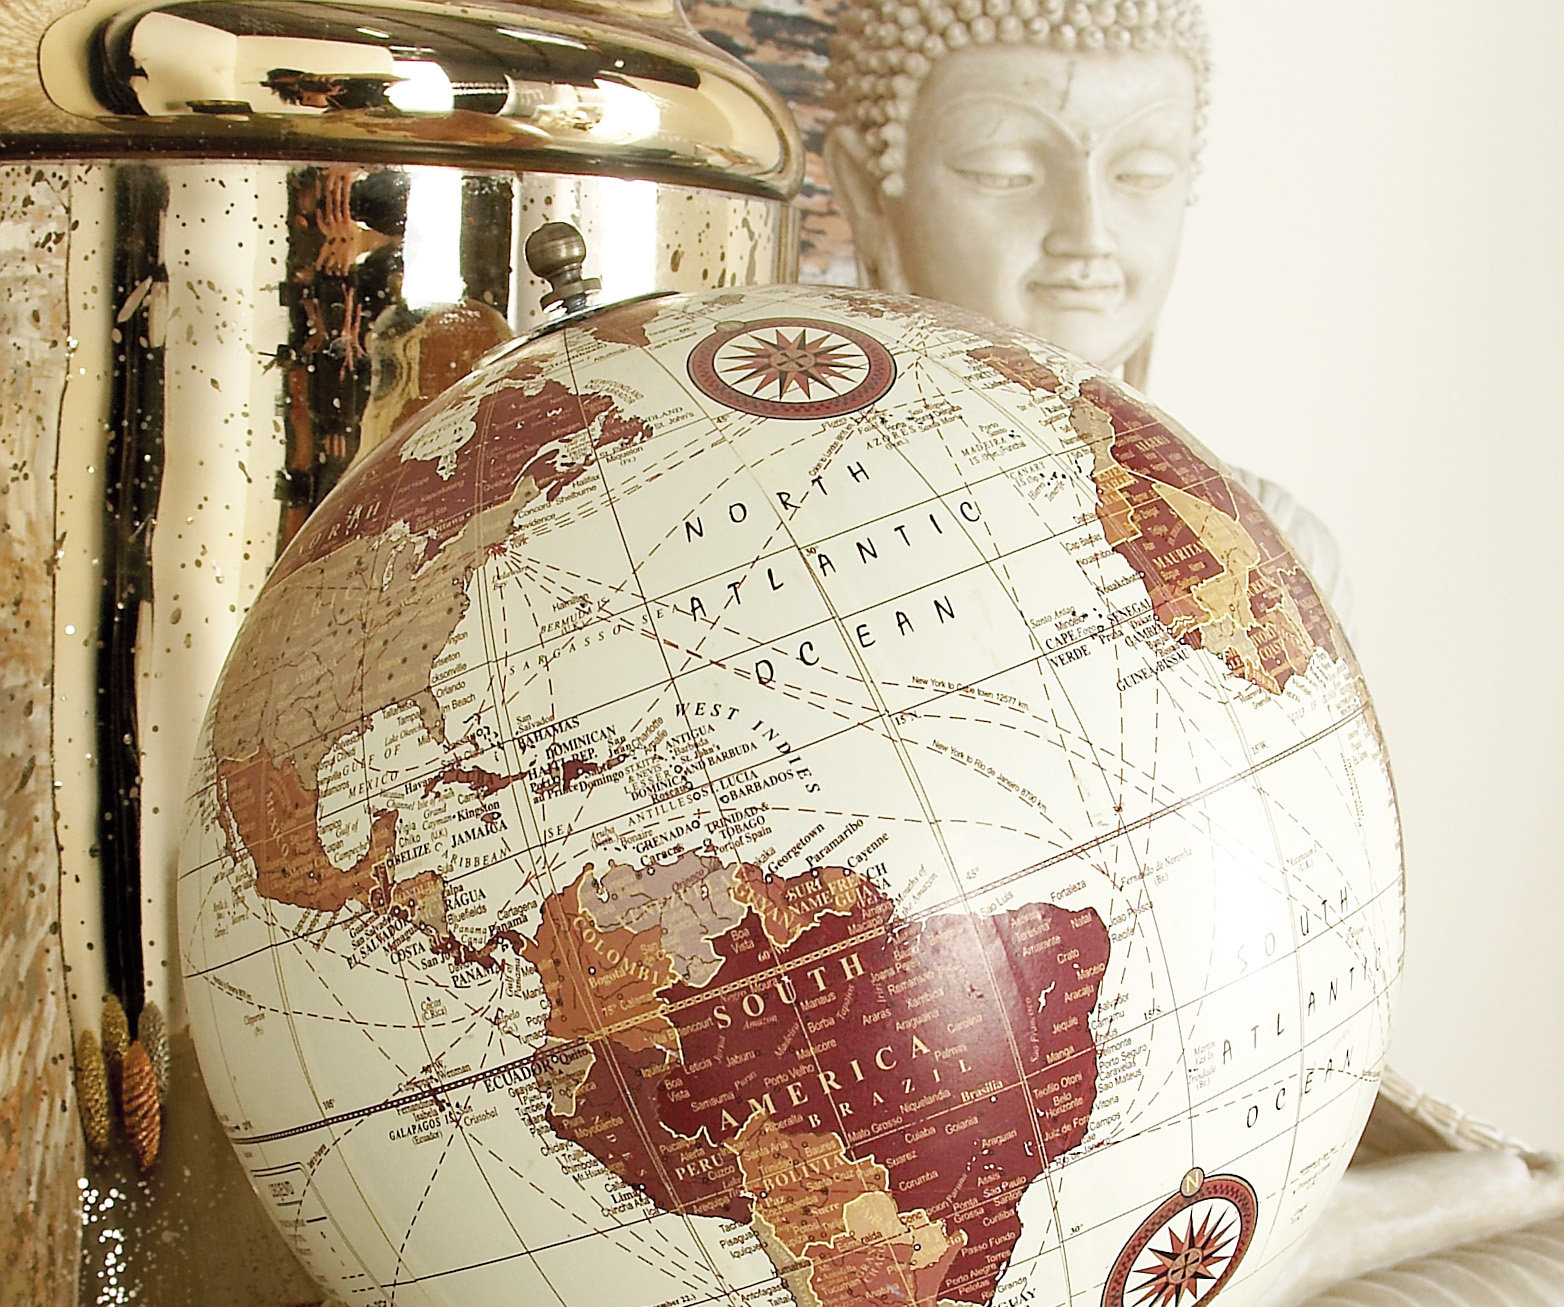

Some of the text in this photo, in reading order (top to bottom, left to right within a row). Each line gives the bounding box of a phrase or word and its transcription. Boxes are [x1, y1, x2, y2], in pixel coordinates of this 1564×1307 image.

[556, 485, 598, 506] Shelburne
[685, 461, 870, 542] NORTH
[517, 502, 553, 519] Concord
[689, 501, 980, 621] ATLANTIC
[755, 595, 956, 685] OCEAN
[1046, 629, 1077, 650] CAPE
[1049, 645, 1091, 668] VERDE
[435, 680, 466, 699] Orlando
[517, 718, 580, 750] BAHAMAS
[546, 725, 617, 760] DOMINICAN
[665, 724, 715, 749] ANTIGUA
[675, 702, 820, 794] WEST INDIES
[707, 742, 758, 766] BARBUDA
[579, 770, 624, 792] Domingo
[720, 770, 758, 790] LUCIA
[730, 769, 795, 801] BARBADOS
[457, 801, 500, 822] Kingston
[628, 796, 694, 826] ANTILLES
[704, 804, 758, 833] TRINIDAD
[451, 819, 509, 848] JAMAICA
[635, 825, 693, 854] GRENADA
[720, 815, 766, 840] TOBAGO
[744, 825, 772, 845] Spain
[394, 842, 431, 865] BELIZE
[767, 822, 825, 875] Georgetown
[805, 818, 864, 868] Paramaribo
[847, 832, 890, 868] Cayenne
[789, 890, 830, 915] NAME
[1050, 880, 1088, 902] Fortaleza
[390, 942, 426, 966] COSTA
[712, 952, 867, 1030] SOUTH
[800, 992, 837, 1012] Manaus
[807, 1016, 836, 1034] Borba
[484, 1059, 553, 1094] ECUADOR
[720, 1034, 931, 1131] AMERICA
[763, 1063, 815, 1087] Porto Velho
[1246, 1046, 1354, 1128] OCEAN
[808, 1058, 972, 1128] BRAZIL
[960, 1080, 1004, 1103] Brasilia
[389, 1117, 441, 1142] GALAPAGOS
[871, 1114, 904, 1136] Grosso
[1089, 1112, 1121, 1131] Campos
[675, 1152, 724, 1181] PERU
[885, 1150, 918, 1169] Suarez
[706, 1165, 736, 1181] Cuzco
[763, 1156, 846, 1193] BOLIVIA
[899, 1170, 939, 1192] Corumba
[1001, 1175, 1027, 1193] Paulo
[811, 1203, 840, 1219] Sucre
[961, 1231, 1016, 1257] Passo Fundo
[946, 1261, 998, 1288] Porto Alegre
[958, 1278, 990, 1296] Pelotas
